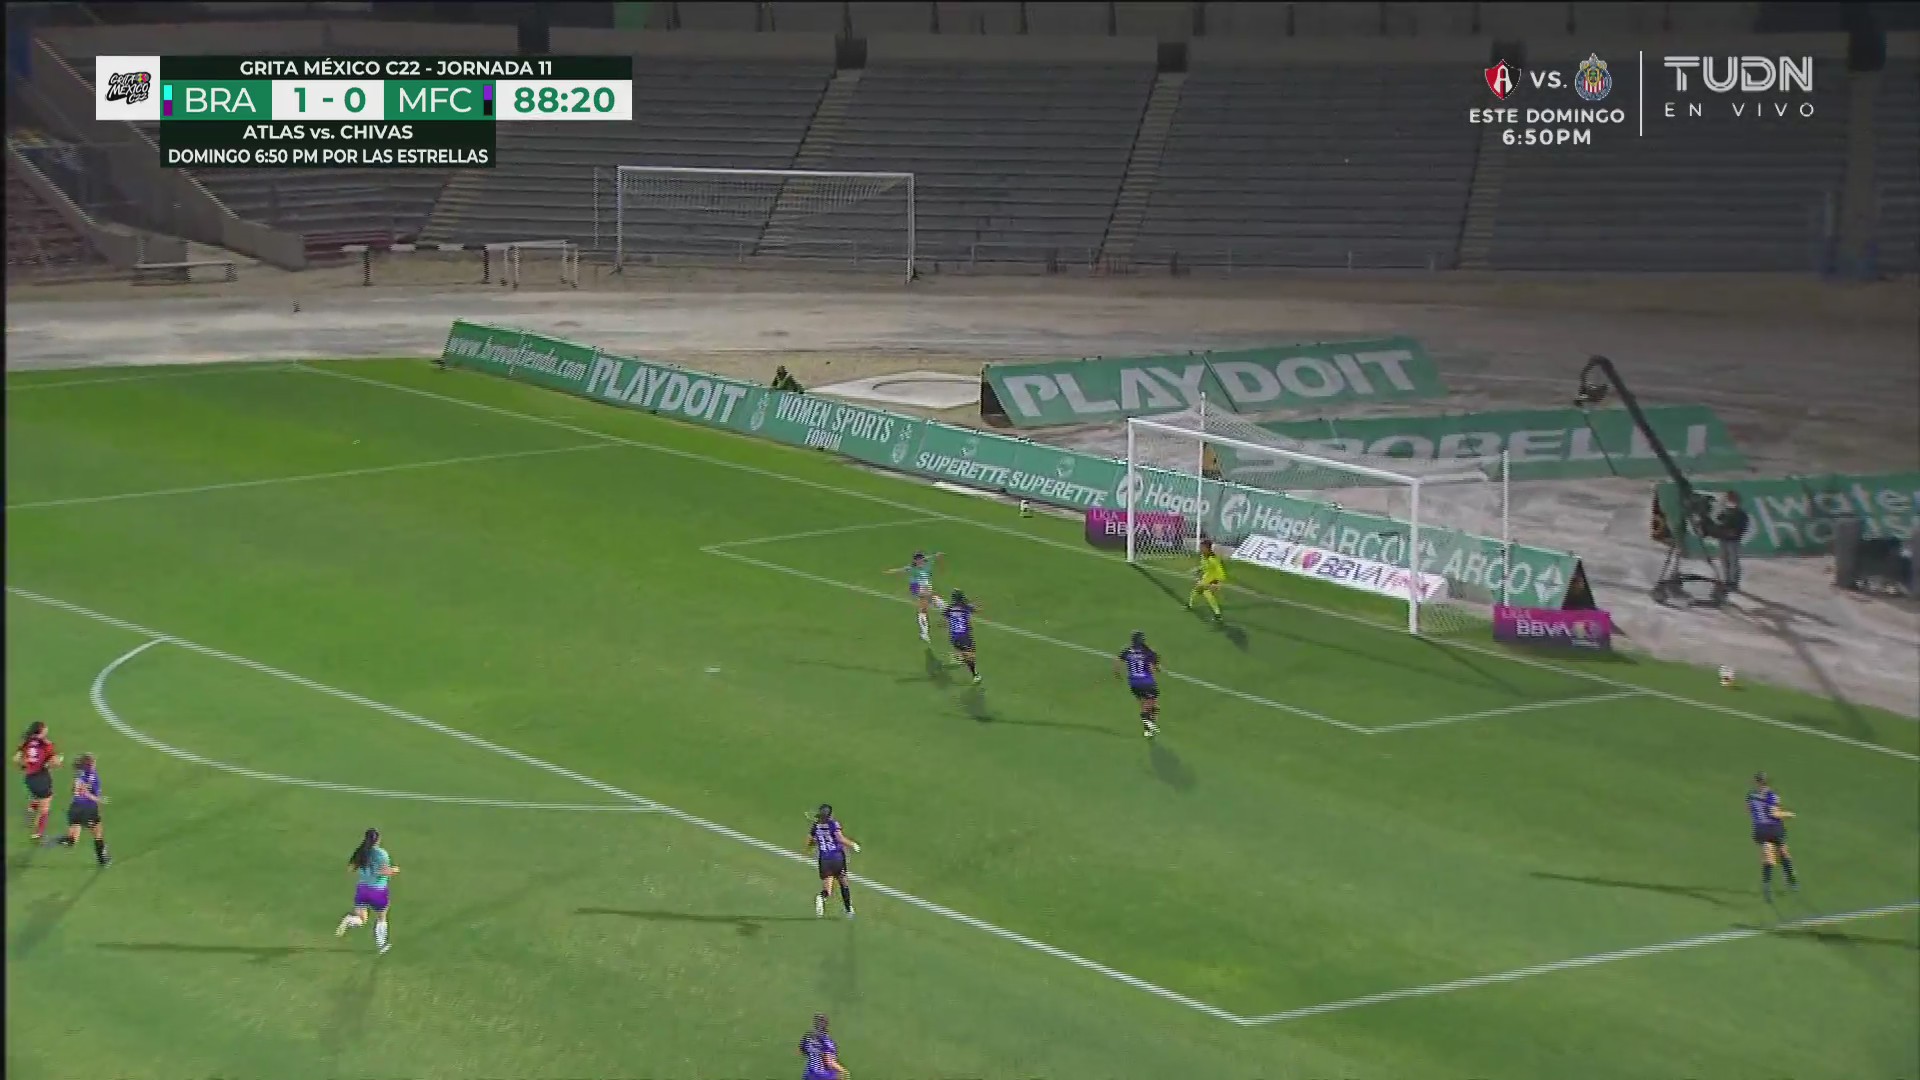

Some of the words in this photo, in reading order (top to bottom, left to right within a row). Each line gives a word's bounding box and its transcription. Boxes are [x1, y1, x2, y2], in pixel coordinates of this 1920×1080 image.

[586, 355, 748, 423] PLAYDOIT
[1003, 349, 1414, 417] PLAYDOIT
[776, 393, 832, 430] WOMEN
[832, 406, 894, 443] SPORTS
[805, 427, 842, 452] FORUM
[915, 451, 1010, 484] SUPERETTE
[1008, 471, 1109, 507] SUPERETTE
[1235, 535, 1290, 567] LIGA
[1319, 525, 1407, 566] ARCO
[1442, 549, 1533, 595] ARCO
[1517, 620, 1573, 638] BBVA
